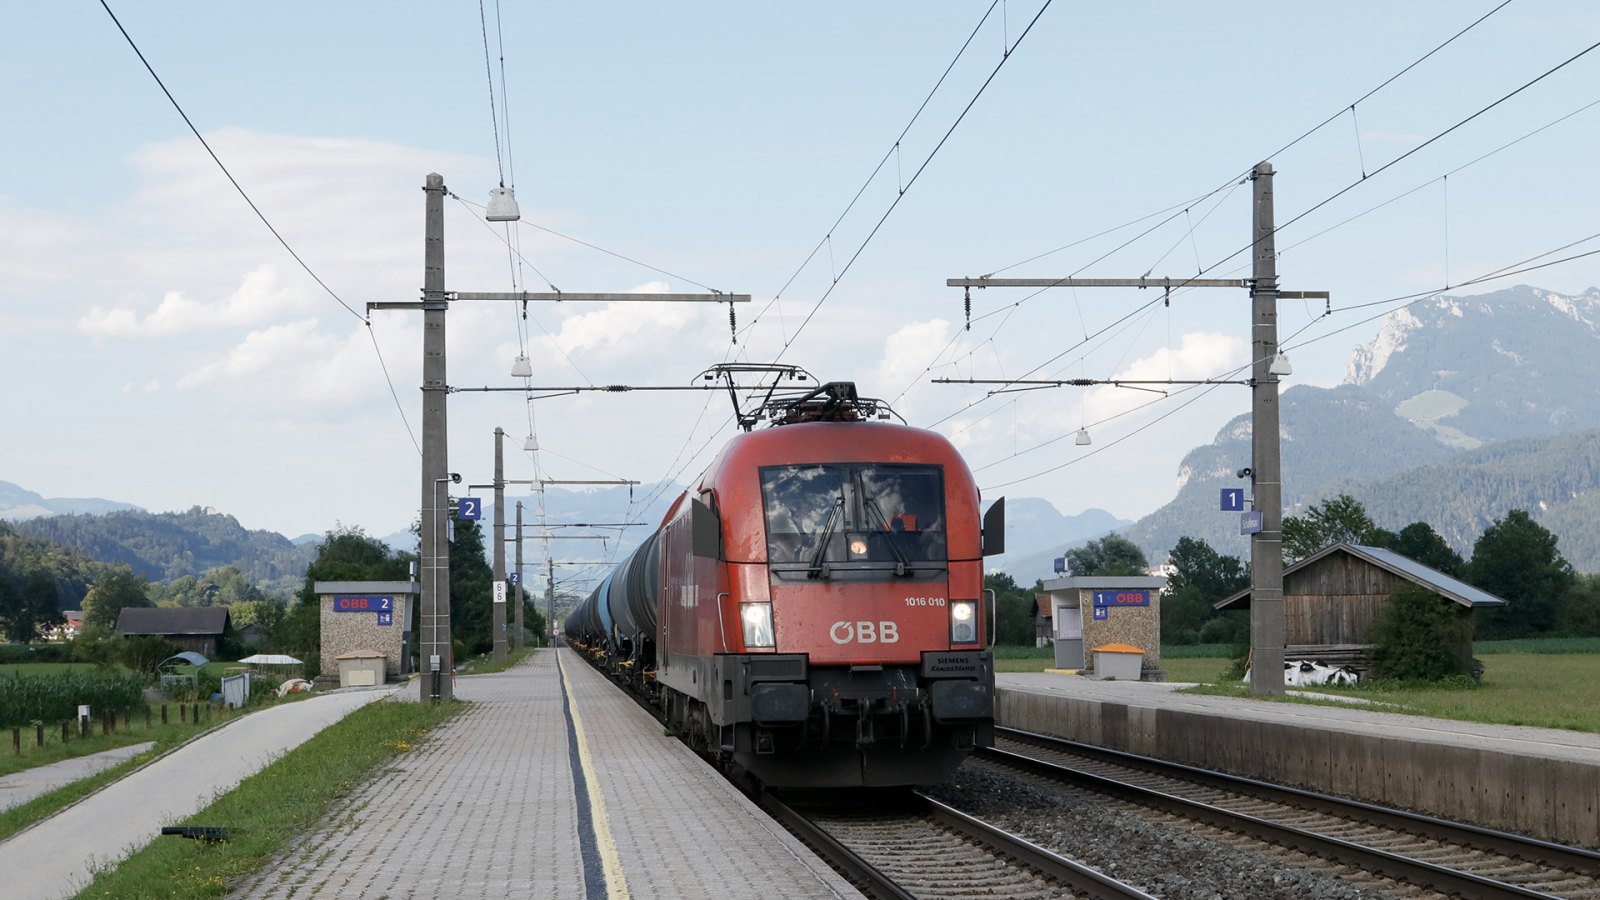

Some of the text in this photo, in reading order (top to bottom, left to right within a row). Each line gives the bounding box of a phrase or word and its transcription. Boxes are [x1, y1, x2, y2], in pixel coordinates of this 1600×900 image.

[1229, 492, 1236, 507] 1
[464, 501, 475, 516] 2
[512, 574, 518, 582] 2
[496, 583, 502, 592] 6
[497, 592, 503, 601] 6
[1097, 593, 1103, 604] 1
[381, 598, 389, 609] 2
[904, 597, 946, 607] 1016 010
[829, 621, 900, 645] ÖBB
[937, 657, 970, 665] SIEMENS
